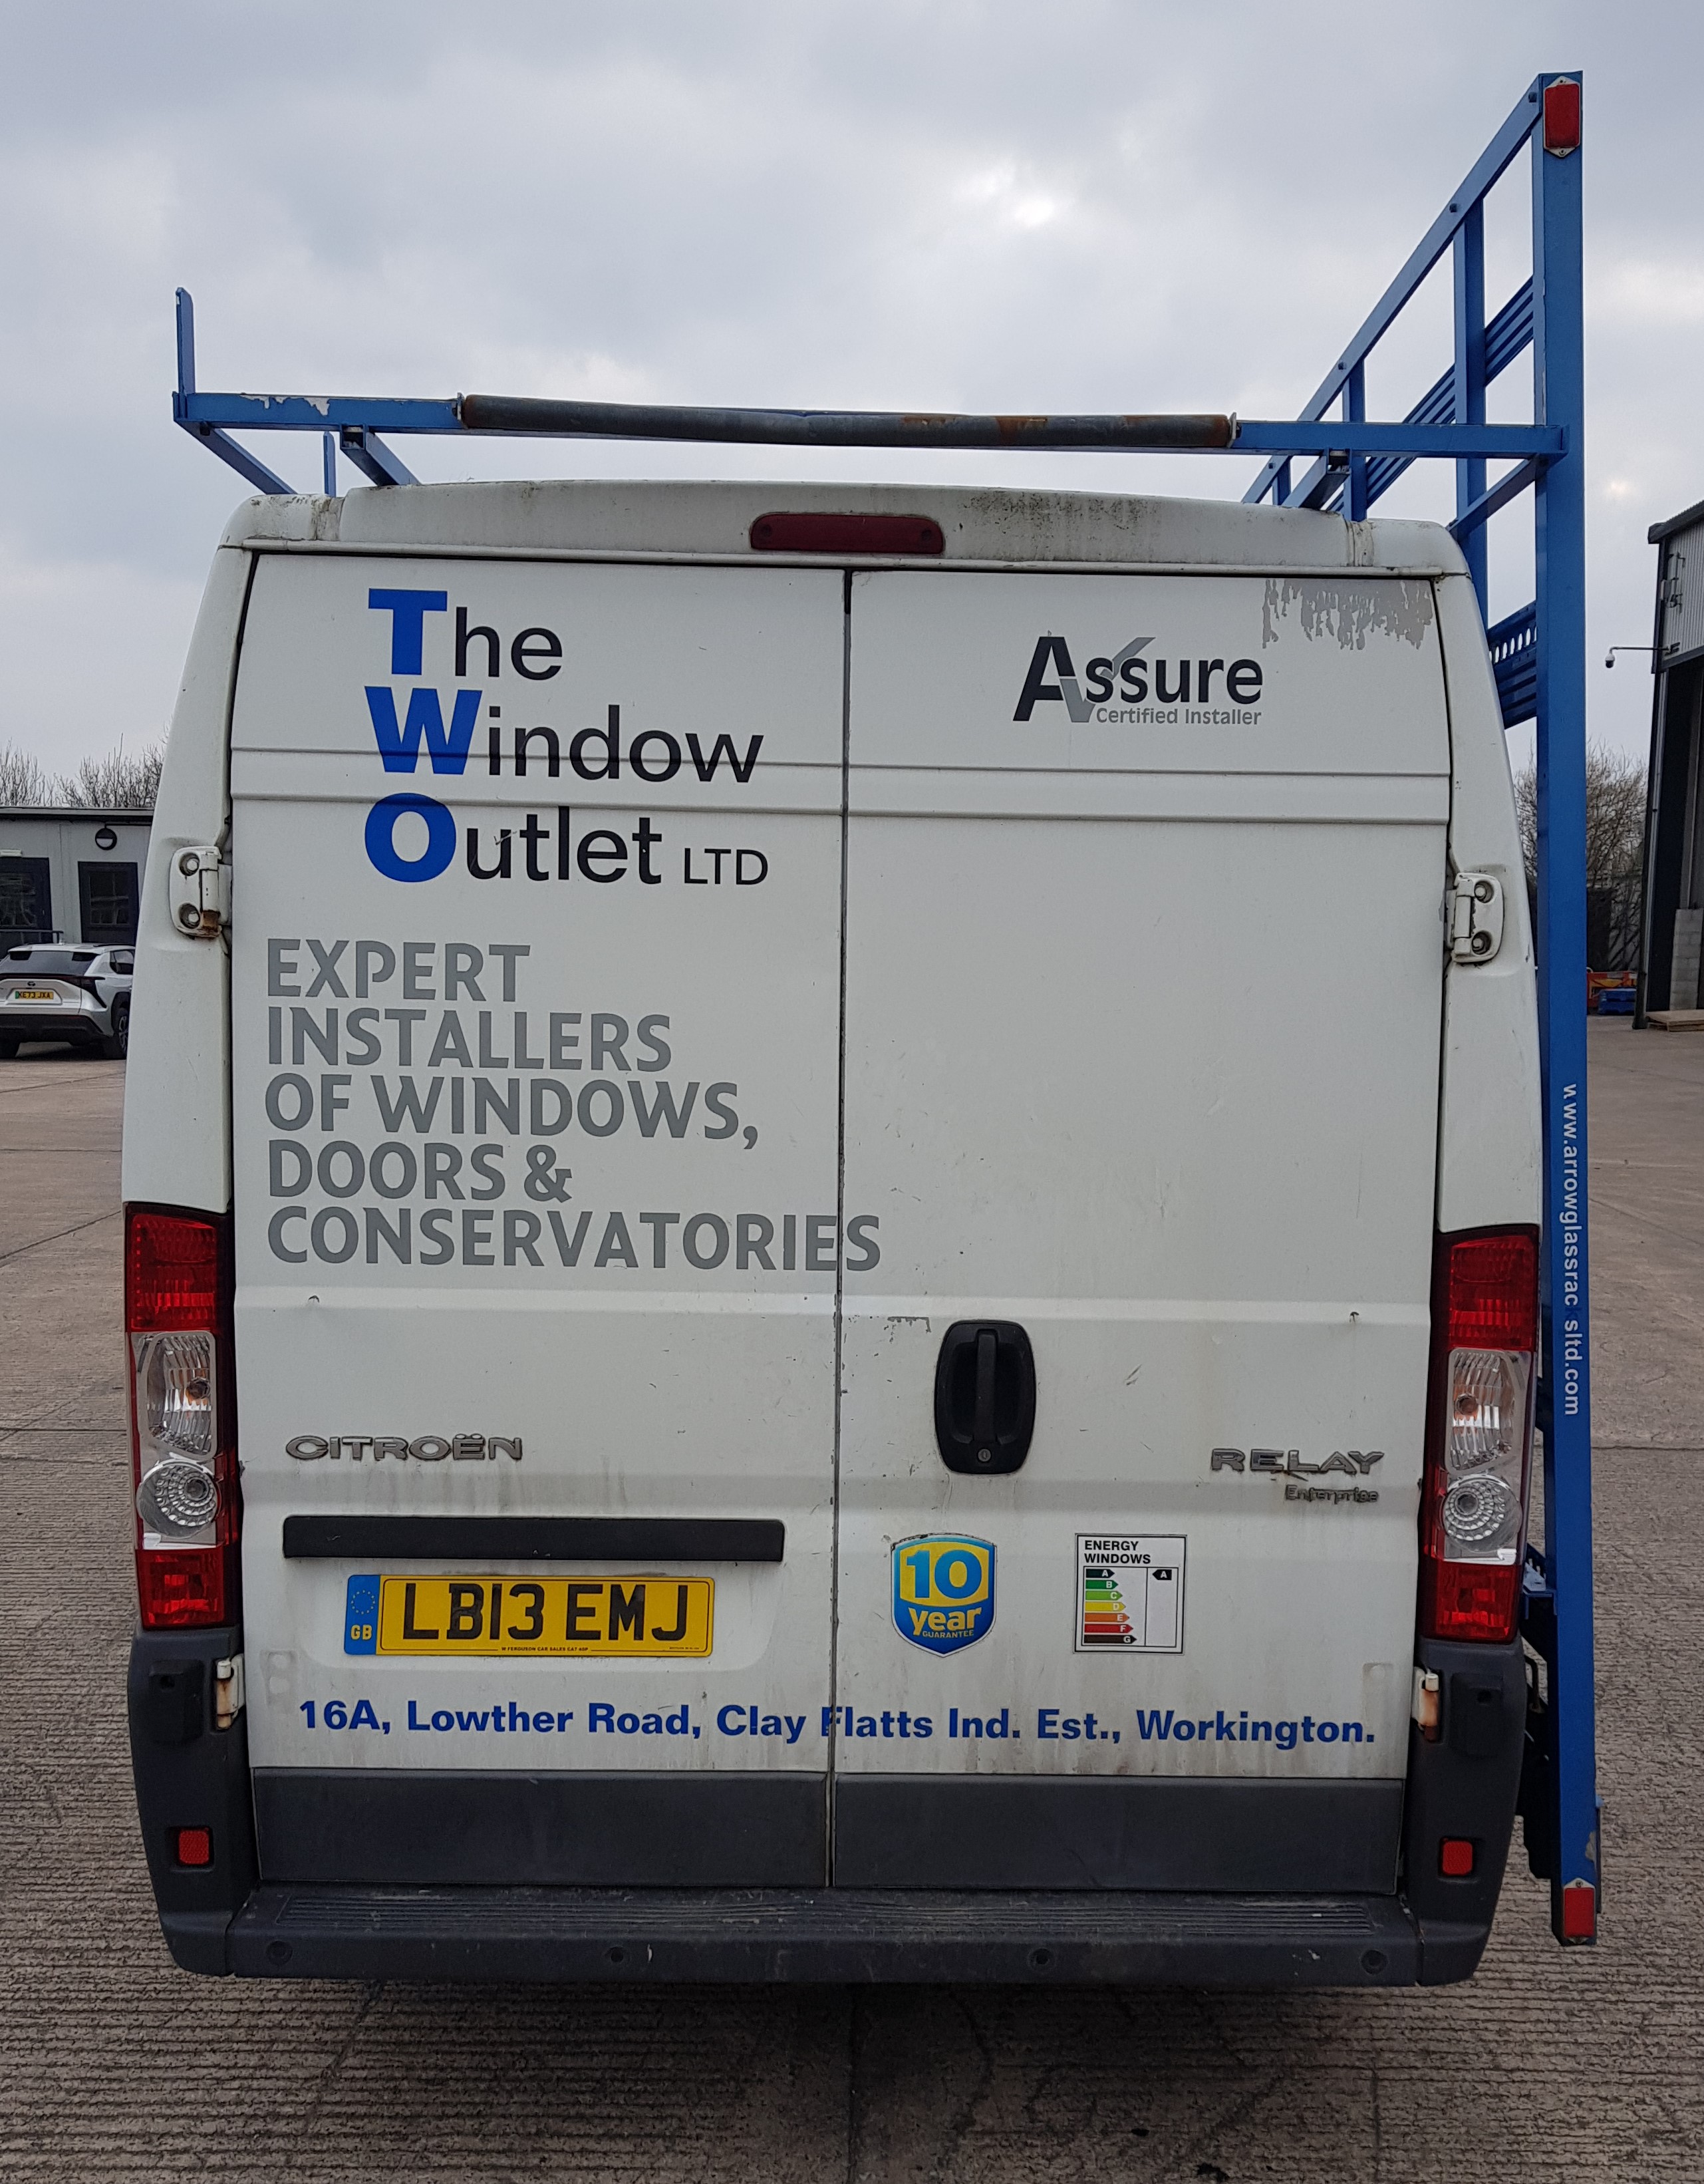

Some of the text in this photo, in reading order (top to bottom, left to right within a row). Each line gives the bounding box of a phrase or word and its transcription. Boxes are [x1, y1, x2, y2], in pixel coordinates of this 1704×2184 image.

[368, 588, 563, 681] The
[1013, 637, 1263, 722] Assure
[364, 686, 764, 784] Window
[1096, 707, 1262, 725] Certified Installer
[364, 792, 768, 885] Outlet LTD
[267, 938, 531, 1003] EXPERT
[267, 1006, 672, 1072] INSTALLERS
[265, 1072, 758, 1150] OF WINDOWS,
[268, 1140, 573, 1203] DOORS &
[267, 1205, 881, 1272] CONSERVATORIES
[286, 1432, 522, 1462] CITROËN
[1211, 1448, 1385, 1474] RELAY
[1285, 1484, 1379, 1504] Enterprise
[1084, 1553, 1151, 1565] WINDOWS
[1085, 1539, 1139, 1551] ENERGY
[907, 1548, 982, 1599] 10
[351, 1625, 372, 1641] GB
[402, 1582, 688, 1642] LB13 EMJ
[909, 1607, 982, 1636] year
[299, 1700, 1375, 1750] 16A, Lowther Road, Clay Flatts Ind. Est., Workington.
